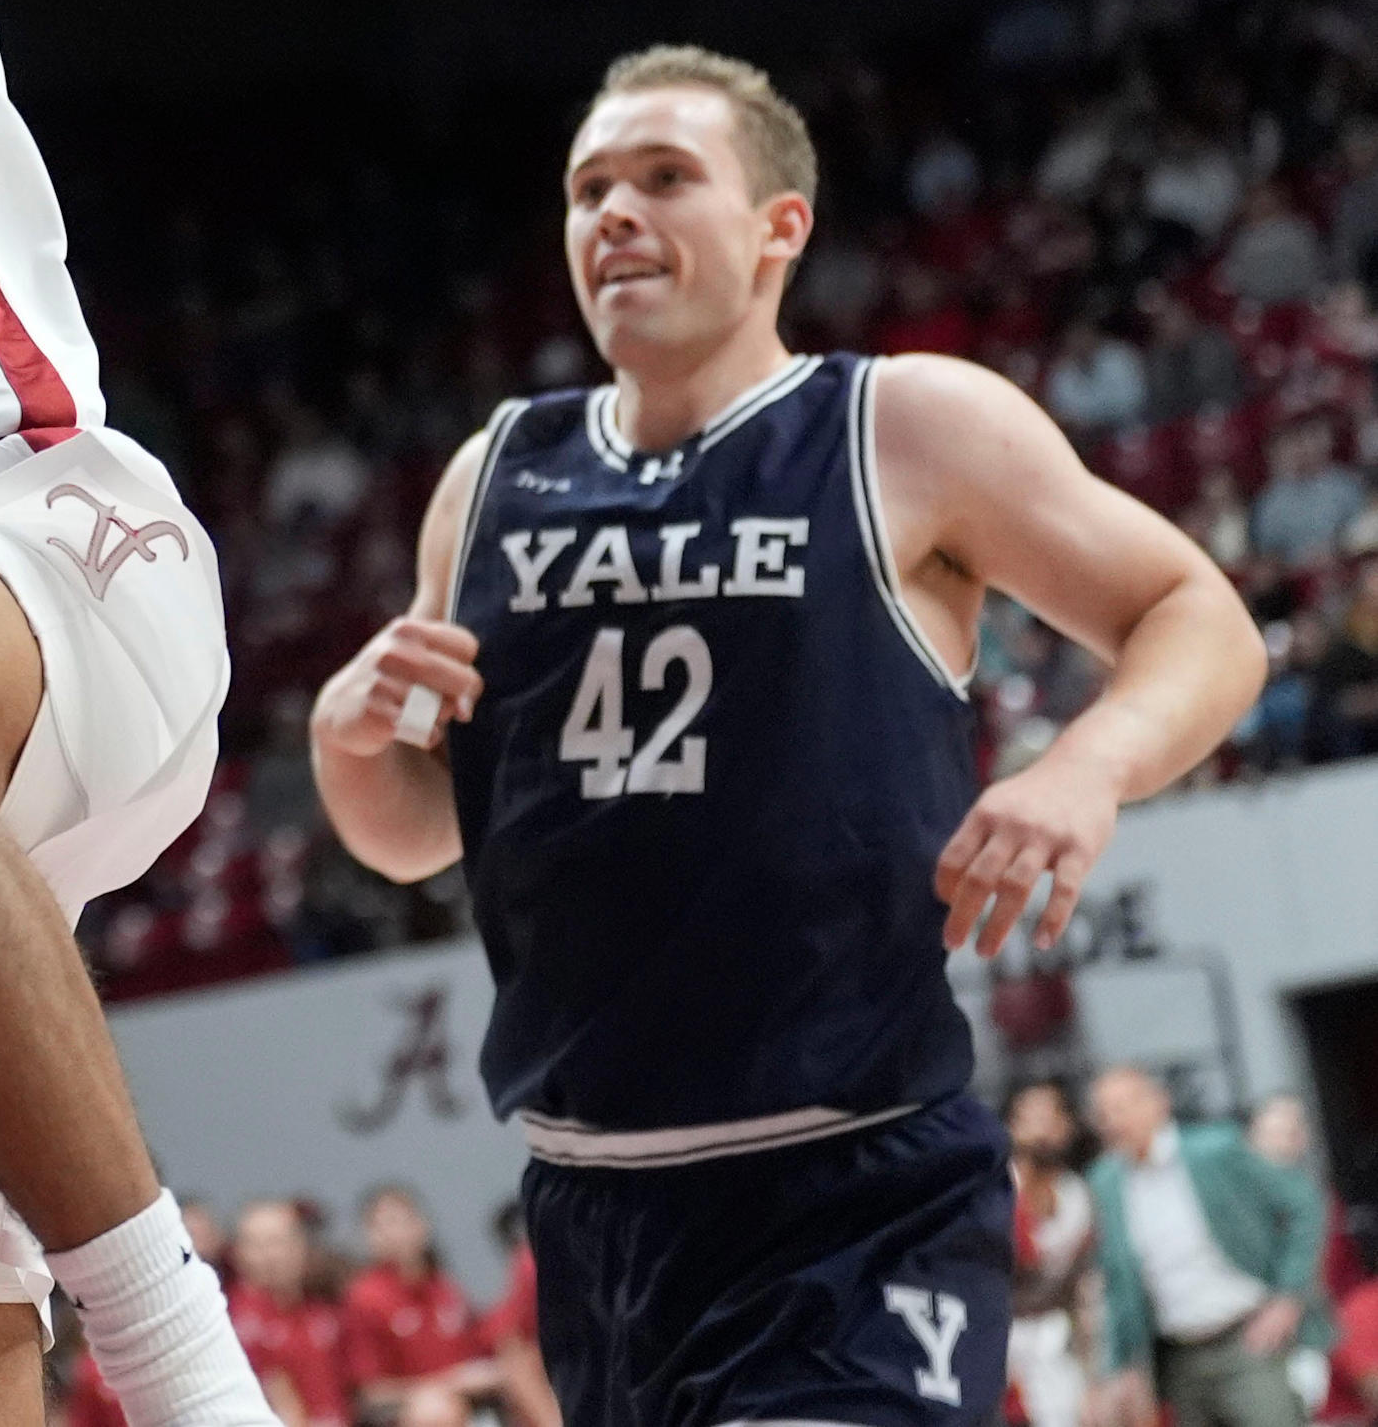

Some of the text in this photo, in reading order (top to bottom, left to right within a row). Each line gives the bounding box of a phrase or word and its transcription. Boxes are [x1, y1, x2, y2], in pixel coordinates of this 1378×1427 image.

[501, 517, 810, 612] YALE
[560, 625, 713, 800] 42
[883, 1284, 969, 1408] Y
